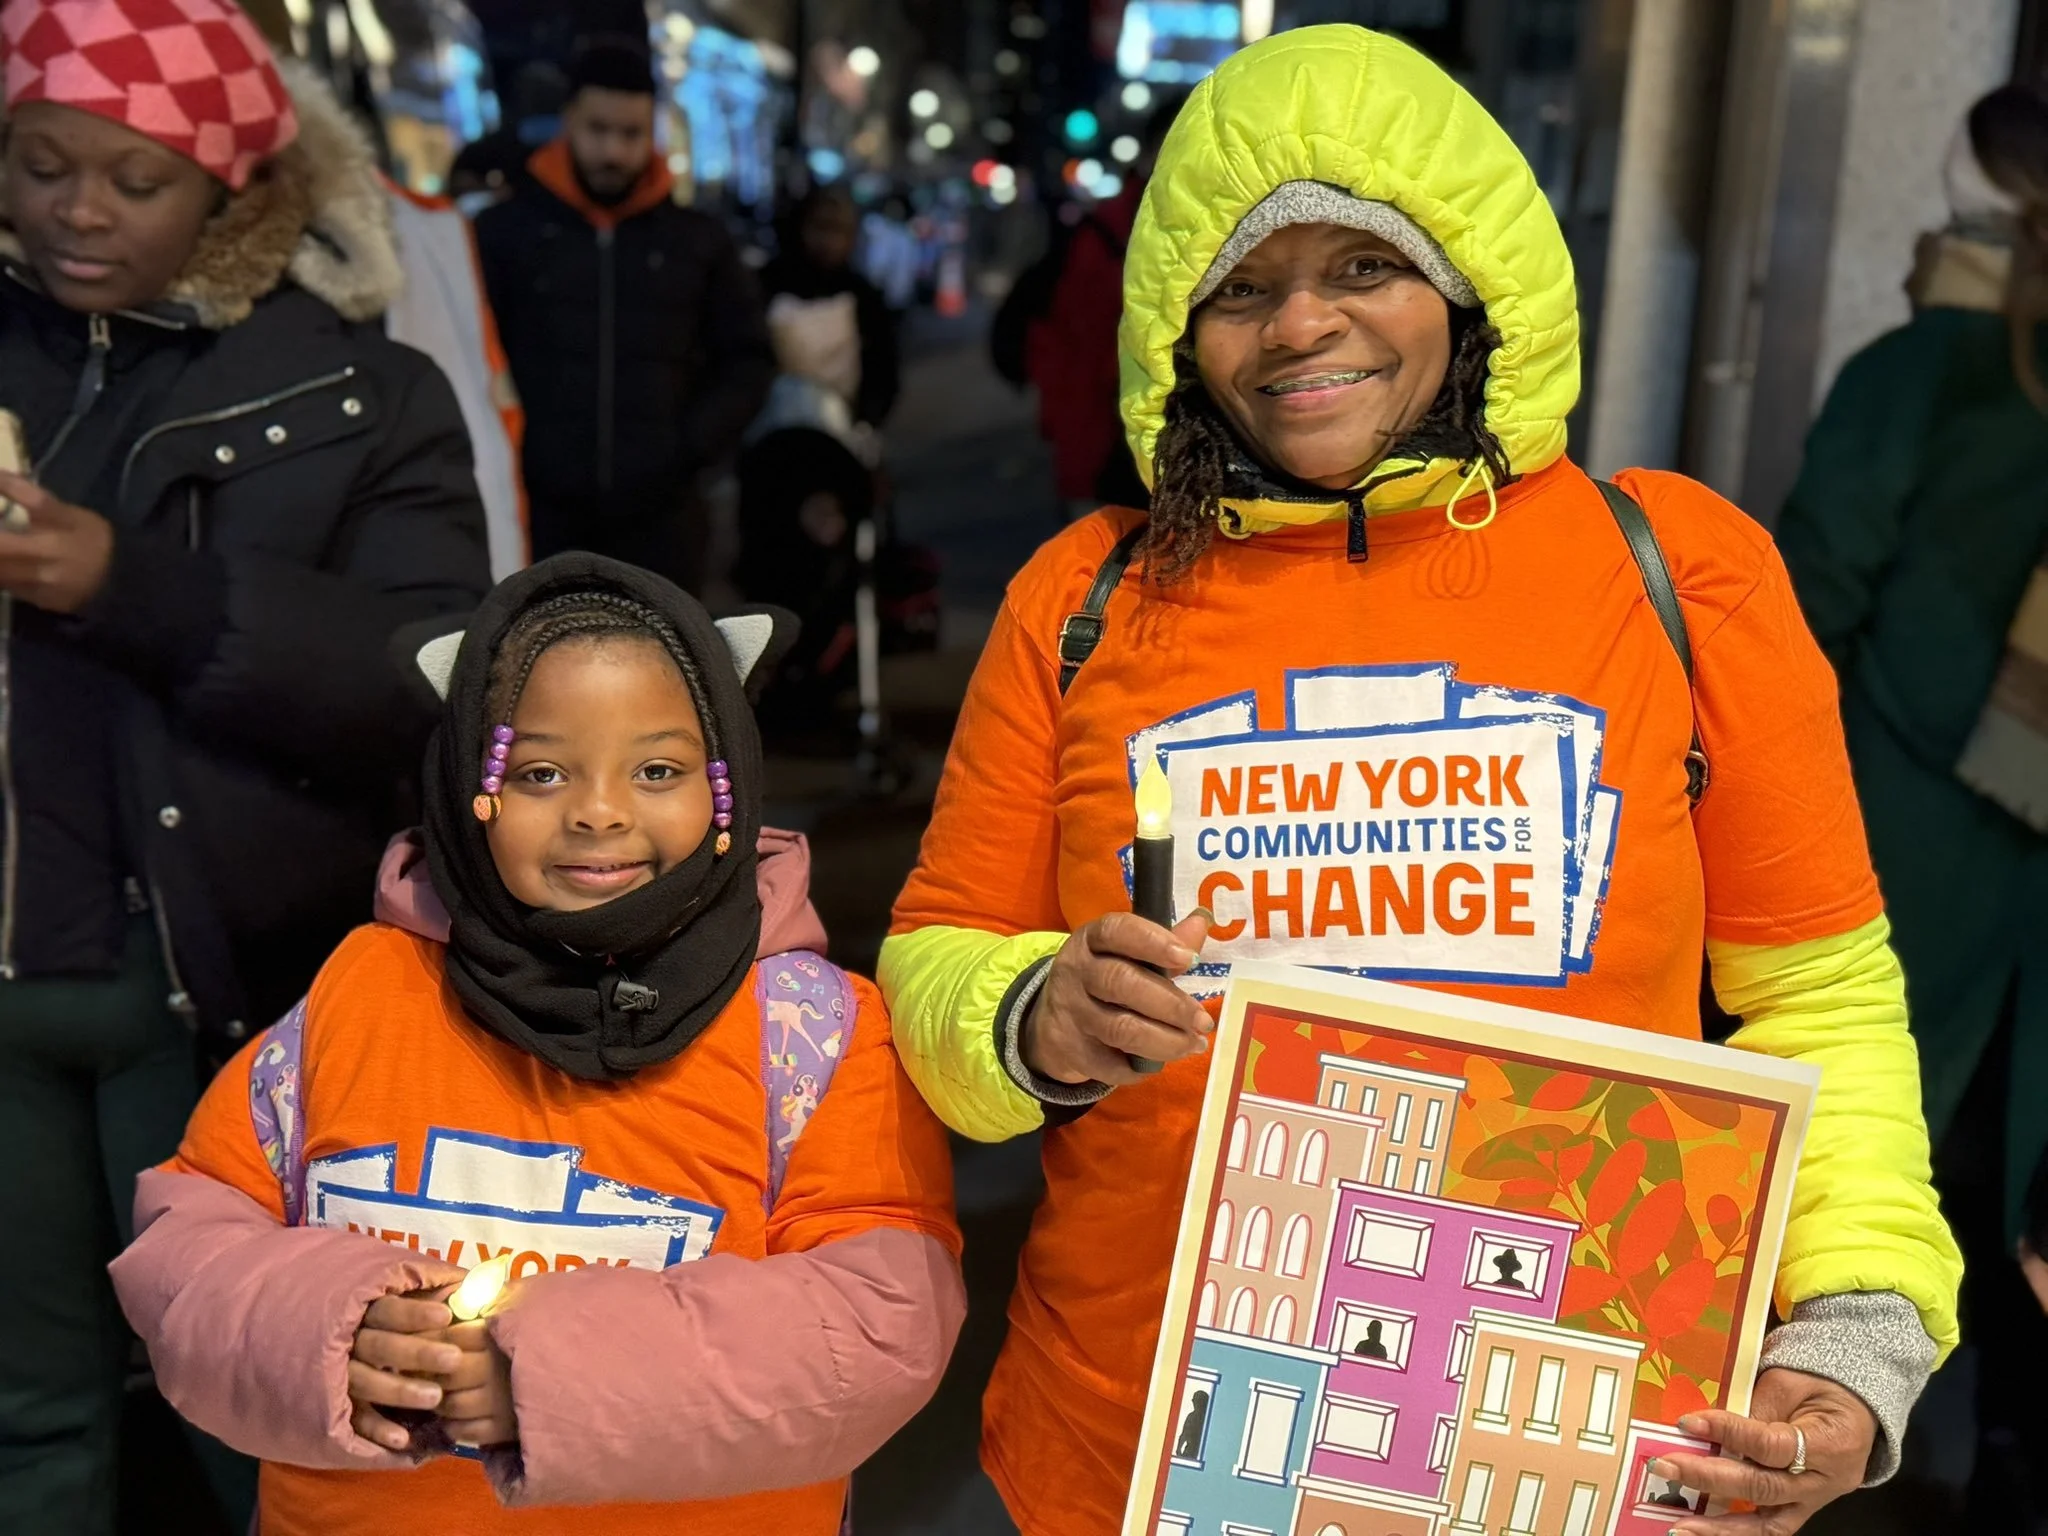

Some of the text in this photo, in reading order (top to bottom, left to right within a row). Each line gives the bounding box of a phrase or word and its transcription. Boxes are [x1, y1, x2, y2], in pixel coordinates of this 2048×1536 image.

[1200, 754, 1529, 817] NEW YORK
[1198, 816, 1532, 861] COMMUNITIES FOR
[1198, 862, 1535, 942] CHANGE
